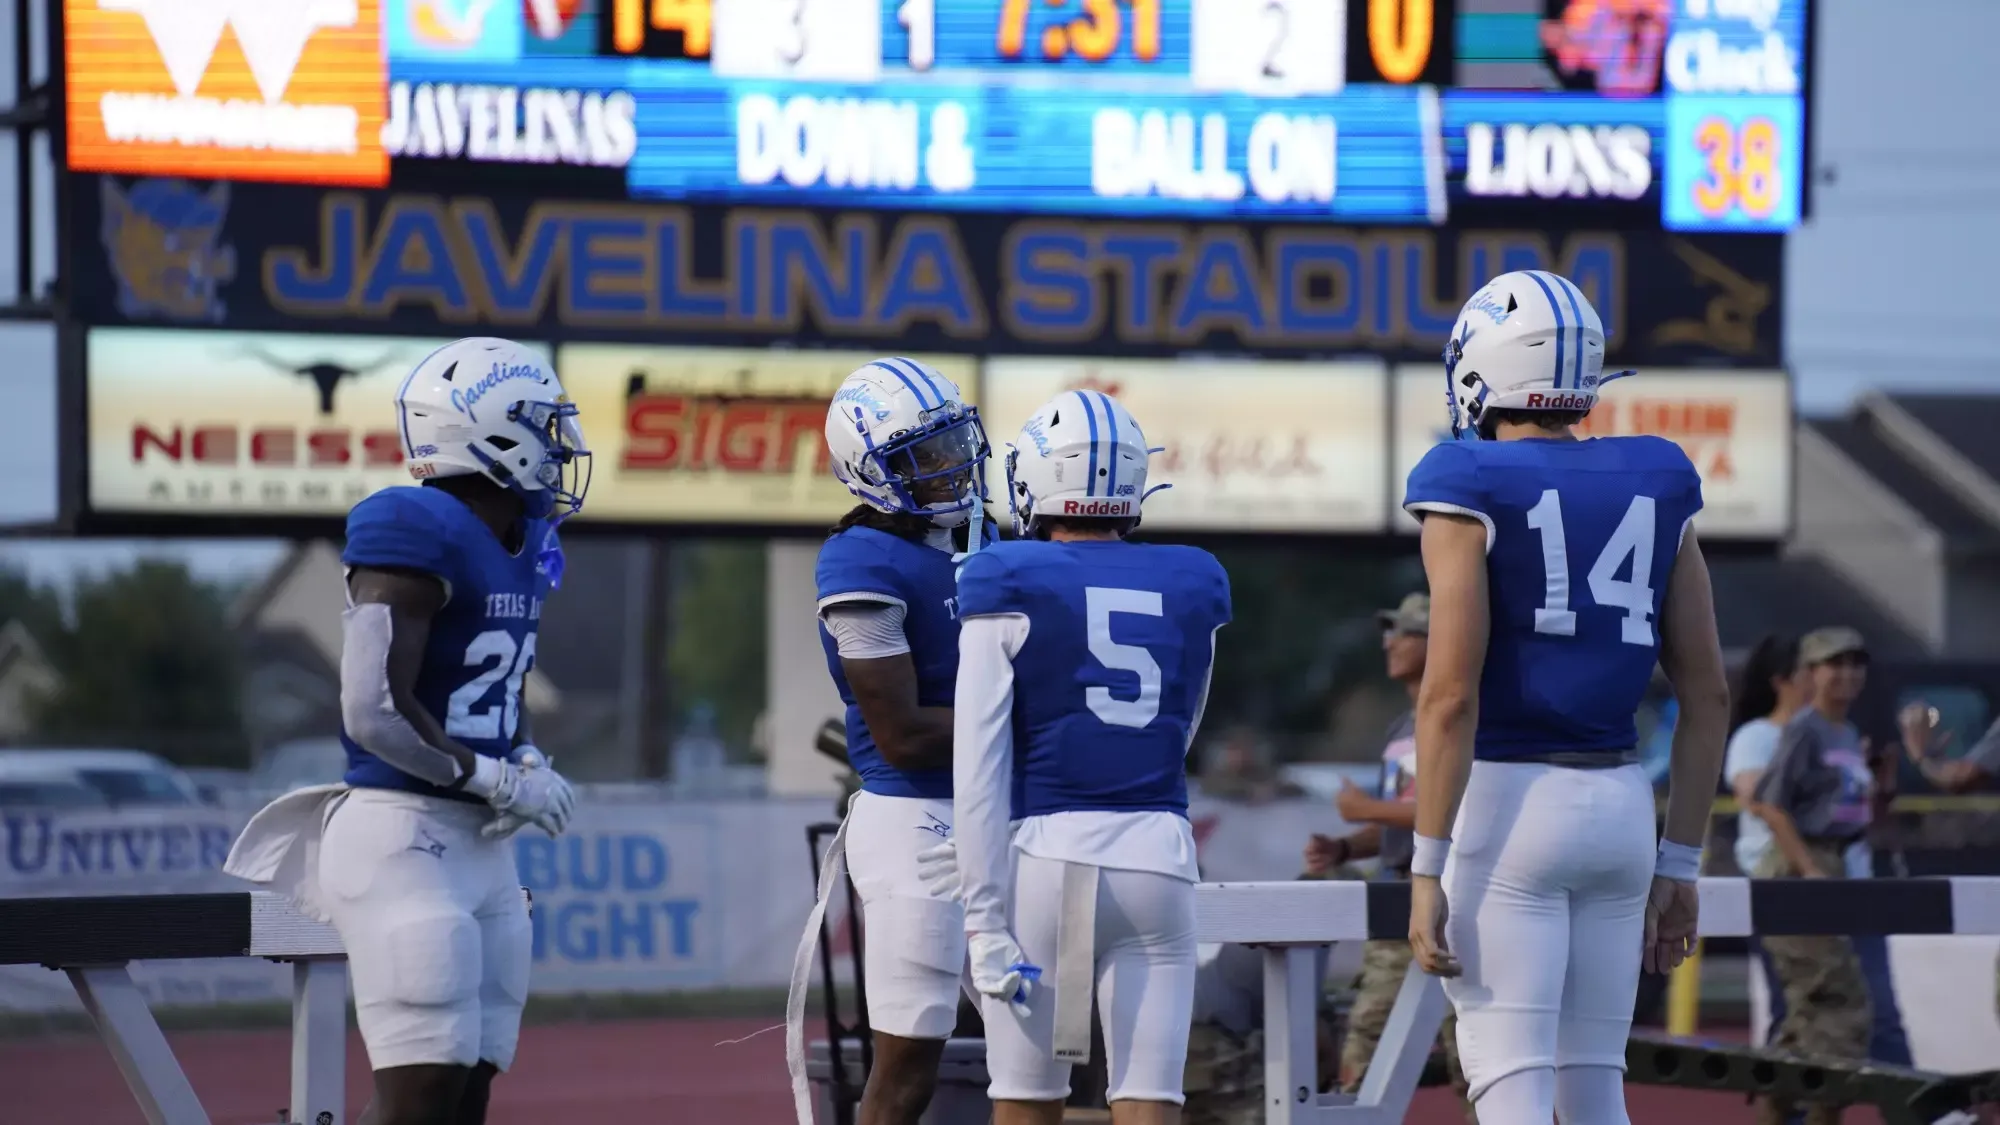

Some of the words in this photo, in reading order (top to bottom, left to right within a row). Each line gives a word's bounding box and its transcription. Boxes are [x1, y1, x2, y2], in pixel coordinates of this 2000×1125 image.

[380, 80, 637, 167] JAVELINAS
[736, 94, 919, 188] DOWN
[926, 101, 976, 191] &
[1092, 107, 1245, 199] BALL
[1247, 112, 1338, 202] ON
[1464, 121, 1652, 199] LIONS
[1691, 115, 1782, 219] 38
[263, 195, 986, 336] JAVELINA
[451, 362, 542, 423] Javelinas
[1526, 393, 1594, 408] Riddell
[131, 424, 405, 470] NEESS
[1064, 500, 1131, 515] Riddell
[1526, 488, 1655, 647] 14
[484, 592, 526, 619] TEXAS
[1085, 586, 1163, 729] 5
[4, 813, 231, 875] UNIVER
[513, 833, 669, 893] BUD
[530, 899, 699, 963] IGHT
